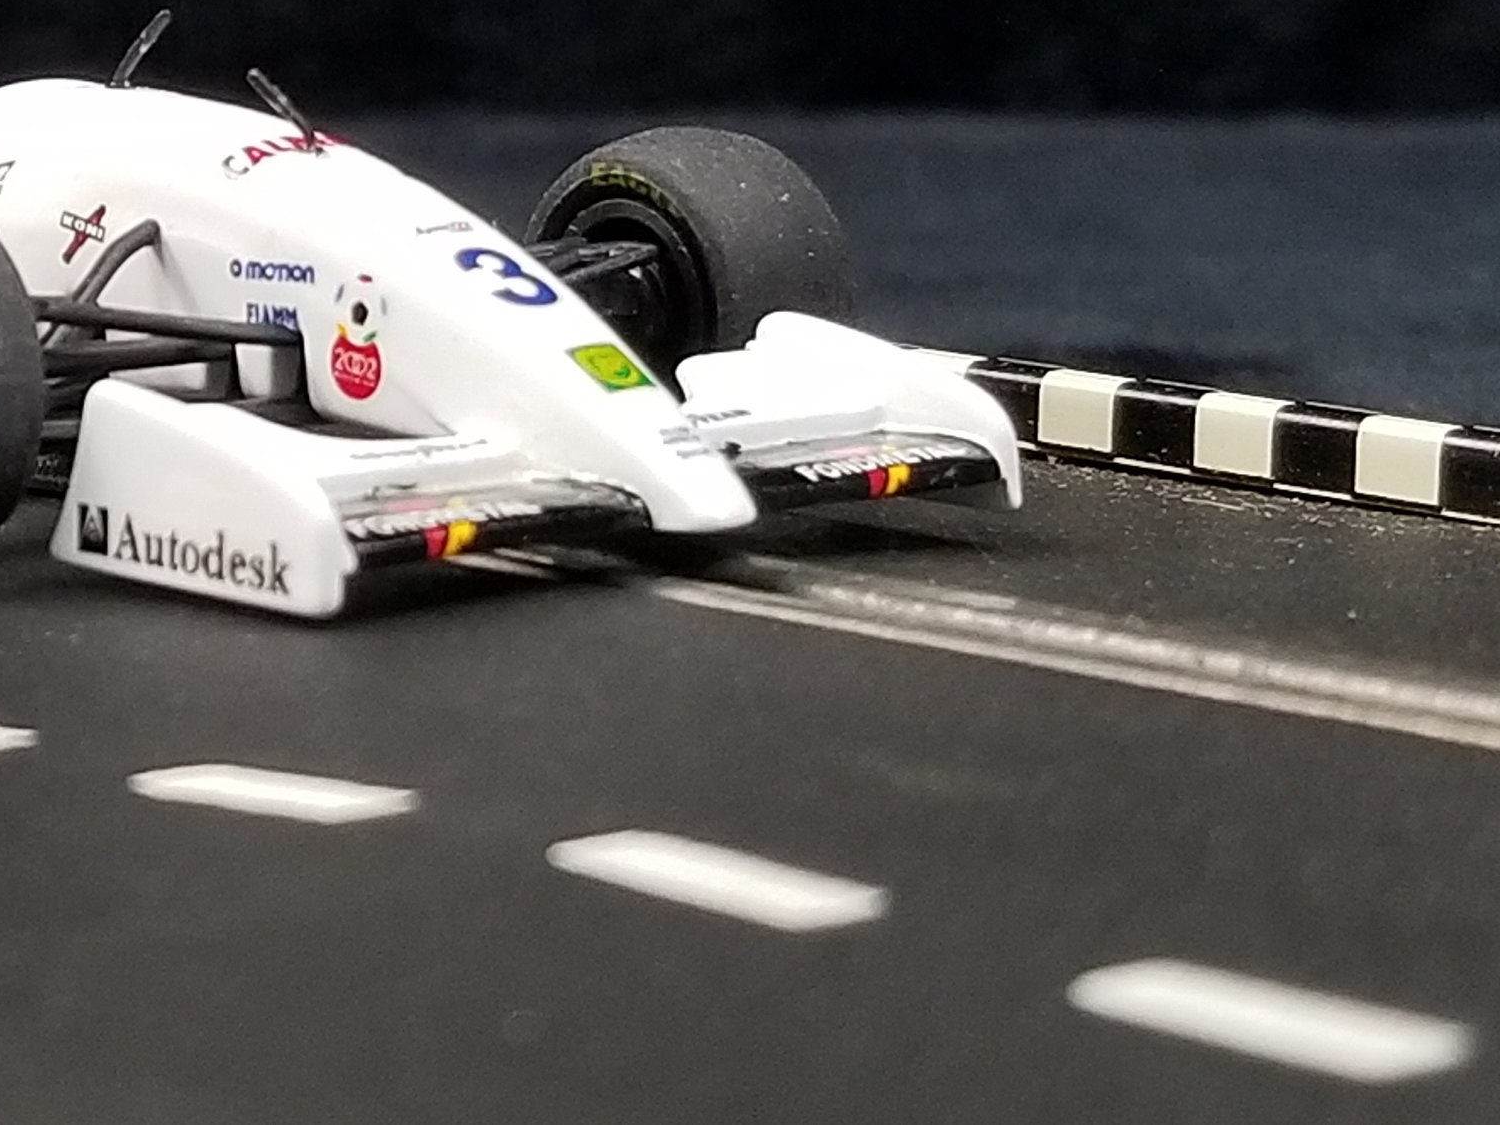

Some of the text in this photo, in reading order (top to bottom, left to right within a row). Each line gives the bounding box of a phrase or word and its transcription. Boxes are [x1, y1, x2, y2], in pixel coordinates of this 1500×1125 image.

[61, 211, 106, 243] KONI
[454, 246, 559, 306] 3
[334, 347, 378, 380] 2002
[113, 511, 290, 595] Autodesk
